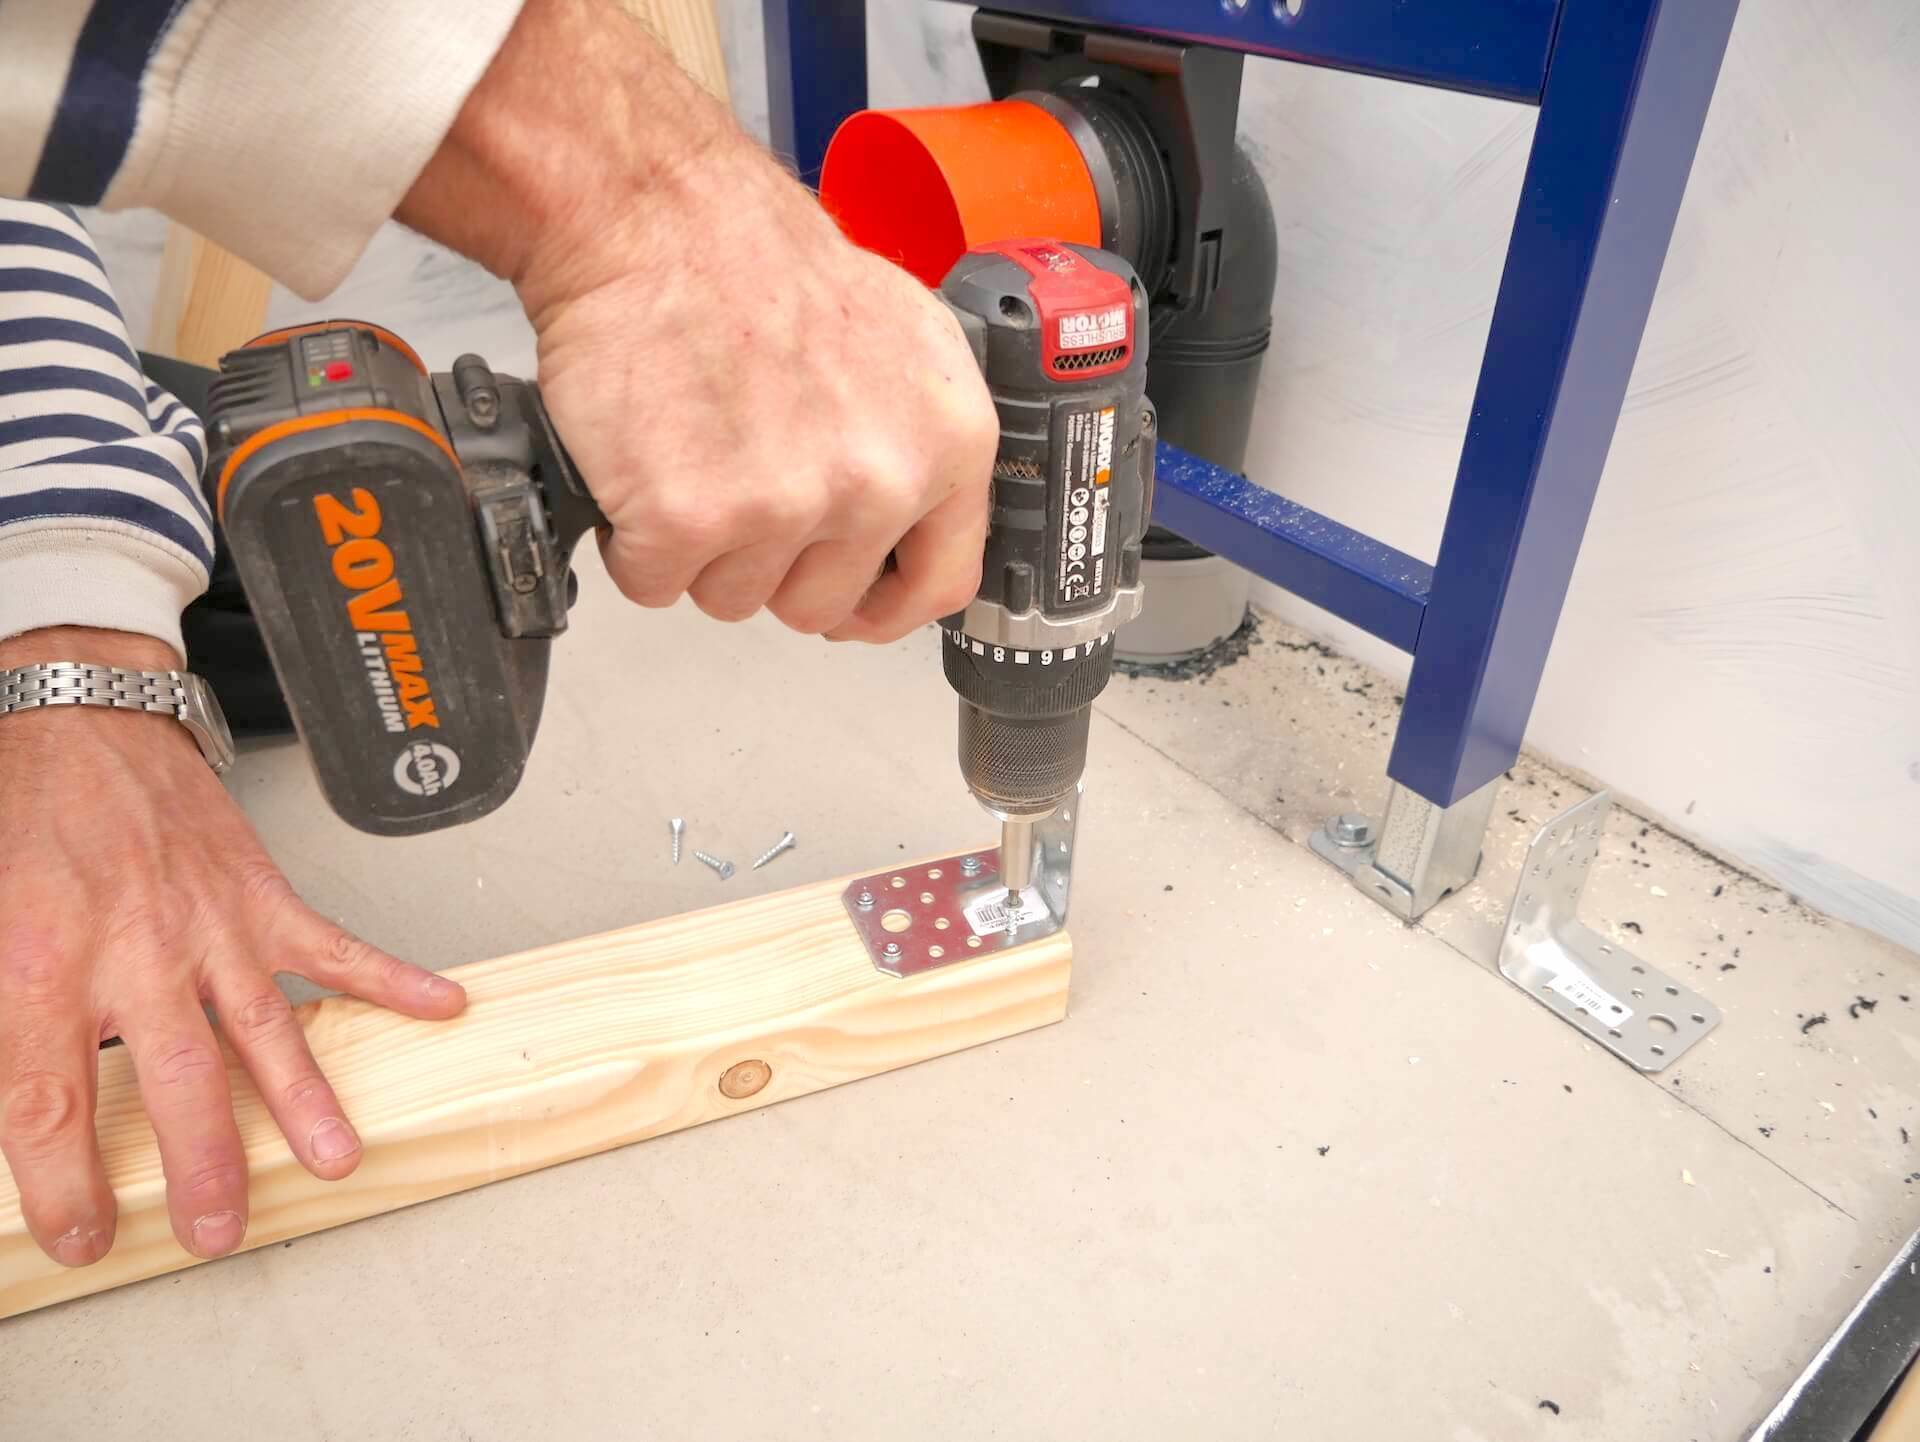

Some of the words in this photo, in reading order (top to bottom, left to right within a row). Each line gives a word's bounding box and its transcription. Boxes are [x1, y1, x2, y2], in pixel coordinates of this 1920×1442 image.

[1062, 309, 1125, 333] MOTOR
[1062, 327, 1124, 346] BRUSHLESS
[1097, 412, 1114, 472] WORX
[953, 630, 968, 649] 10
[1084, 640, 1095, 656] 4
[994, 647, 1005, 662] 8
[1040, 650, 1053, 666] 6
[357, 631, 407, 734] LITHIUM
